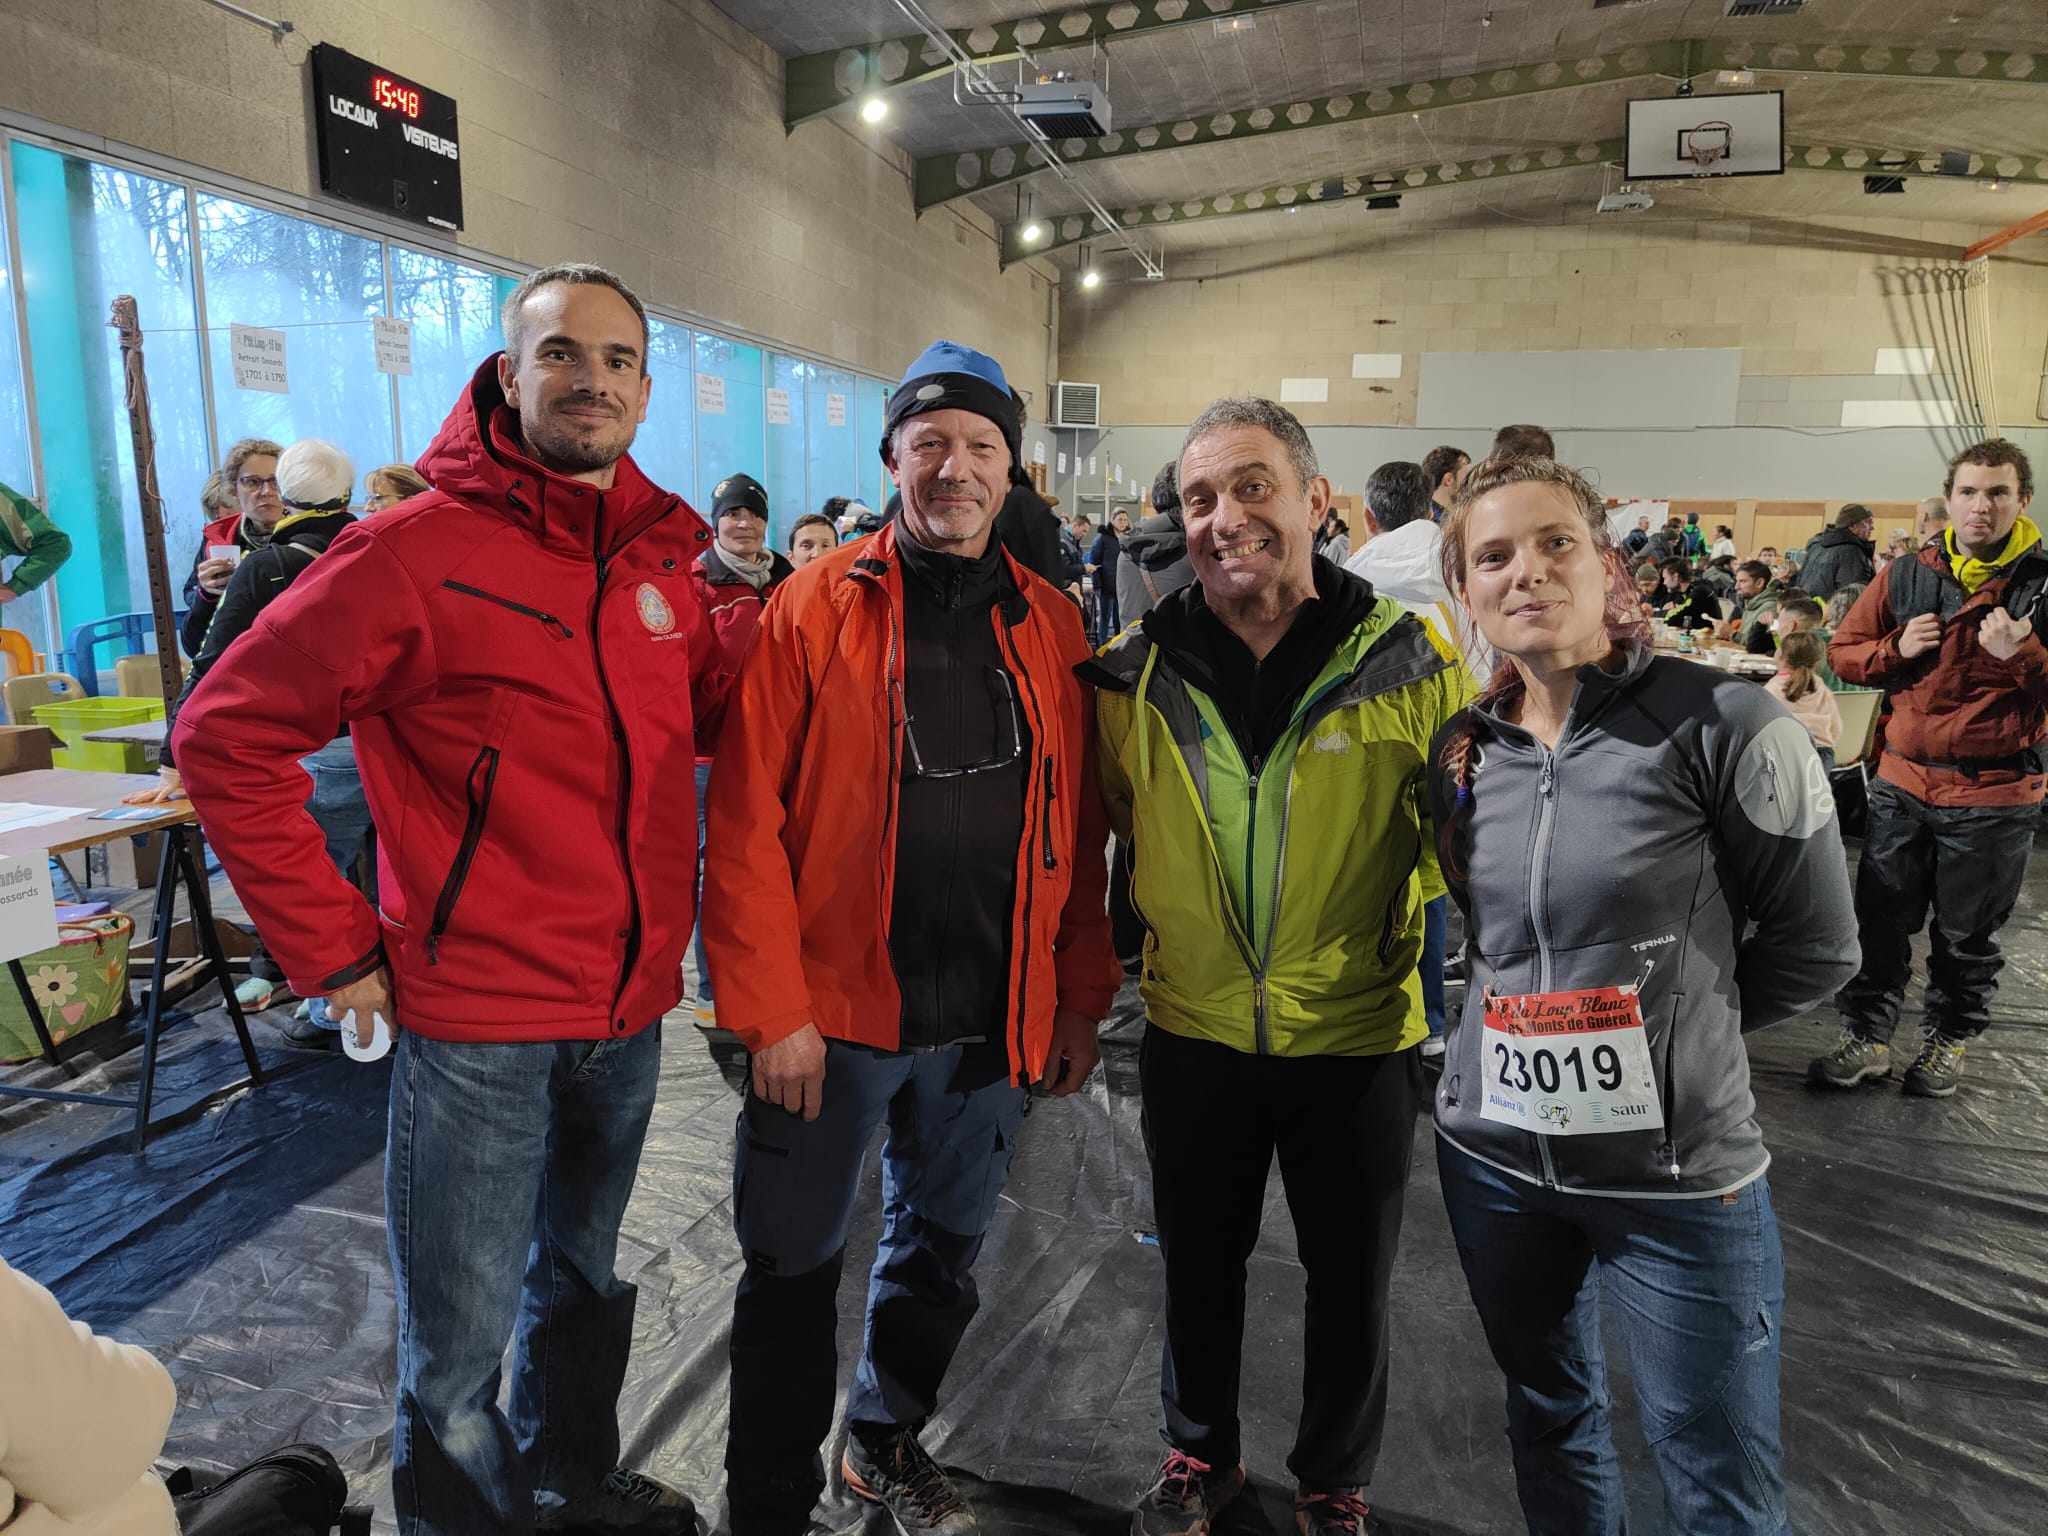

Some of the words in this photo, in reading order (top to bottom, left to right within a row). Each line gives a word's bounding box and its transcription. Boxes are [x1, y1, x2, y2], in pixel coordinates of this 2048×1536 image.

[375, 79, 418, 118] 15:48
[329, 94, 379, 130] LOCAUX
[402, 123, 458, 160] VISITEURS
[1630, 934, 1677, 952] TERNUA
[1531, 1000, 1574, 1019] Loup
[1577, 995, 1629, 1014] Blanc
[1525, 1020, 1565, 1034] Monts
[1567, 1018, 1584, 1030] de
[1587, 1013, 1633, 1029] Guéret
[1494, 1043, 1622, 1094] 23019
[1489, 1094, 1516, 1112] Allianz
[1610, 1102, 1649, 1118] saur
